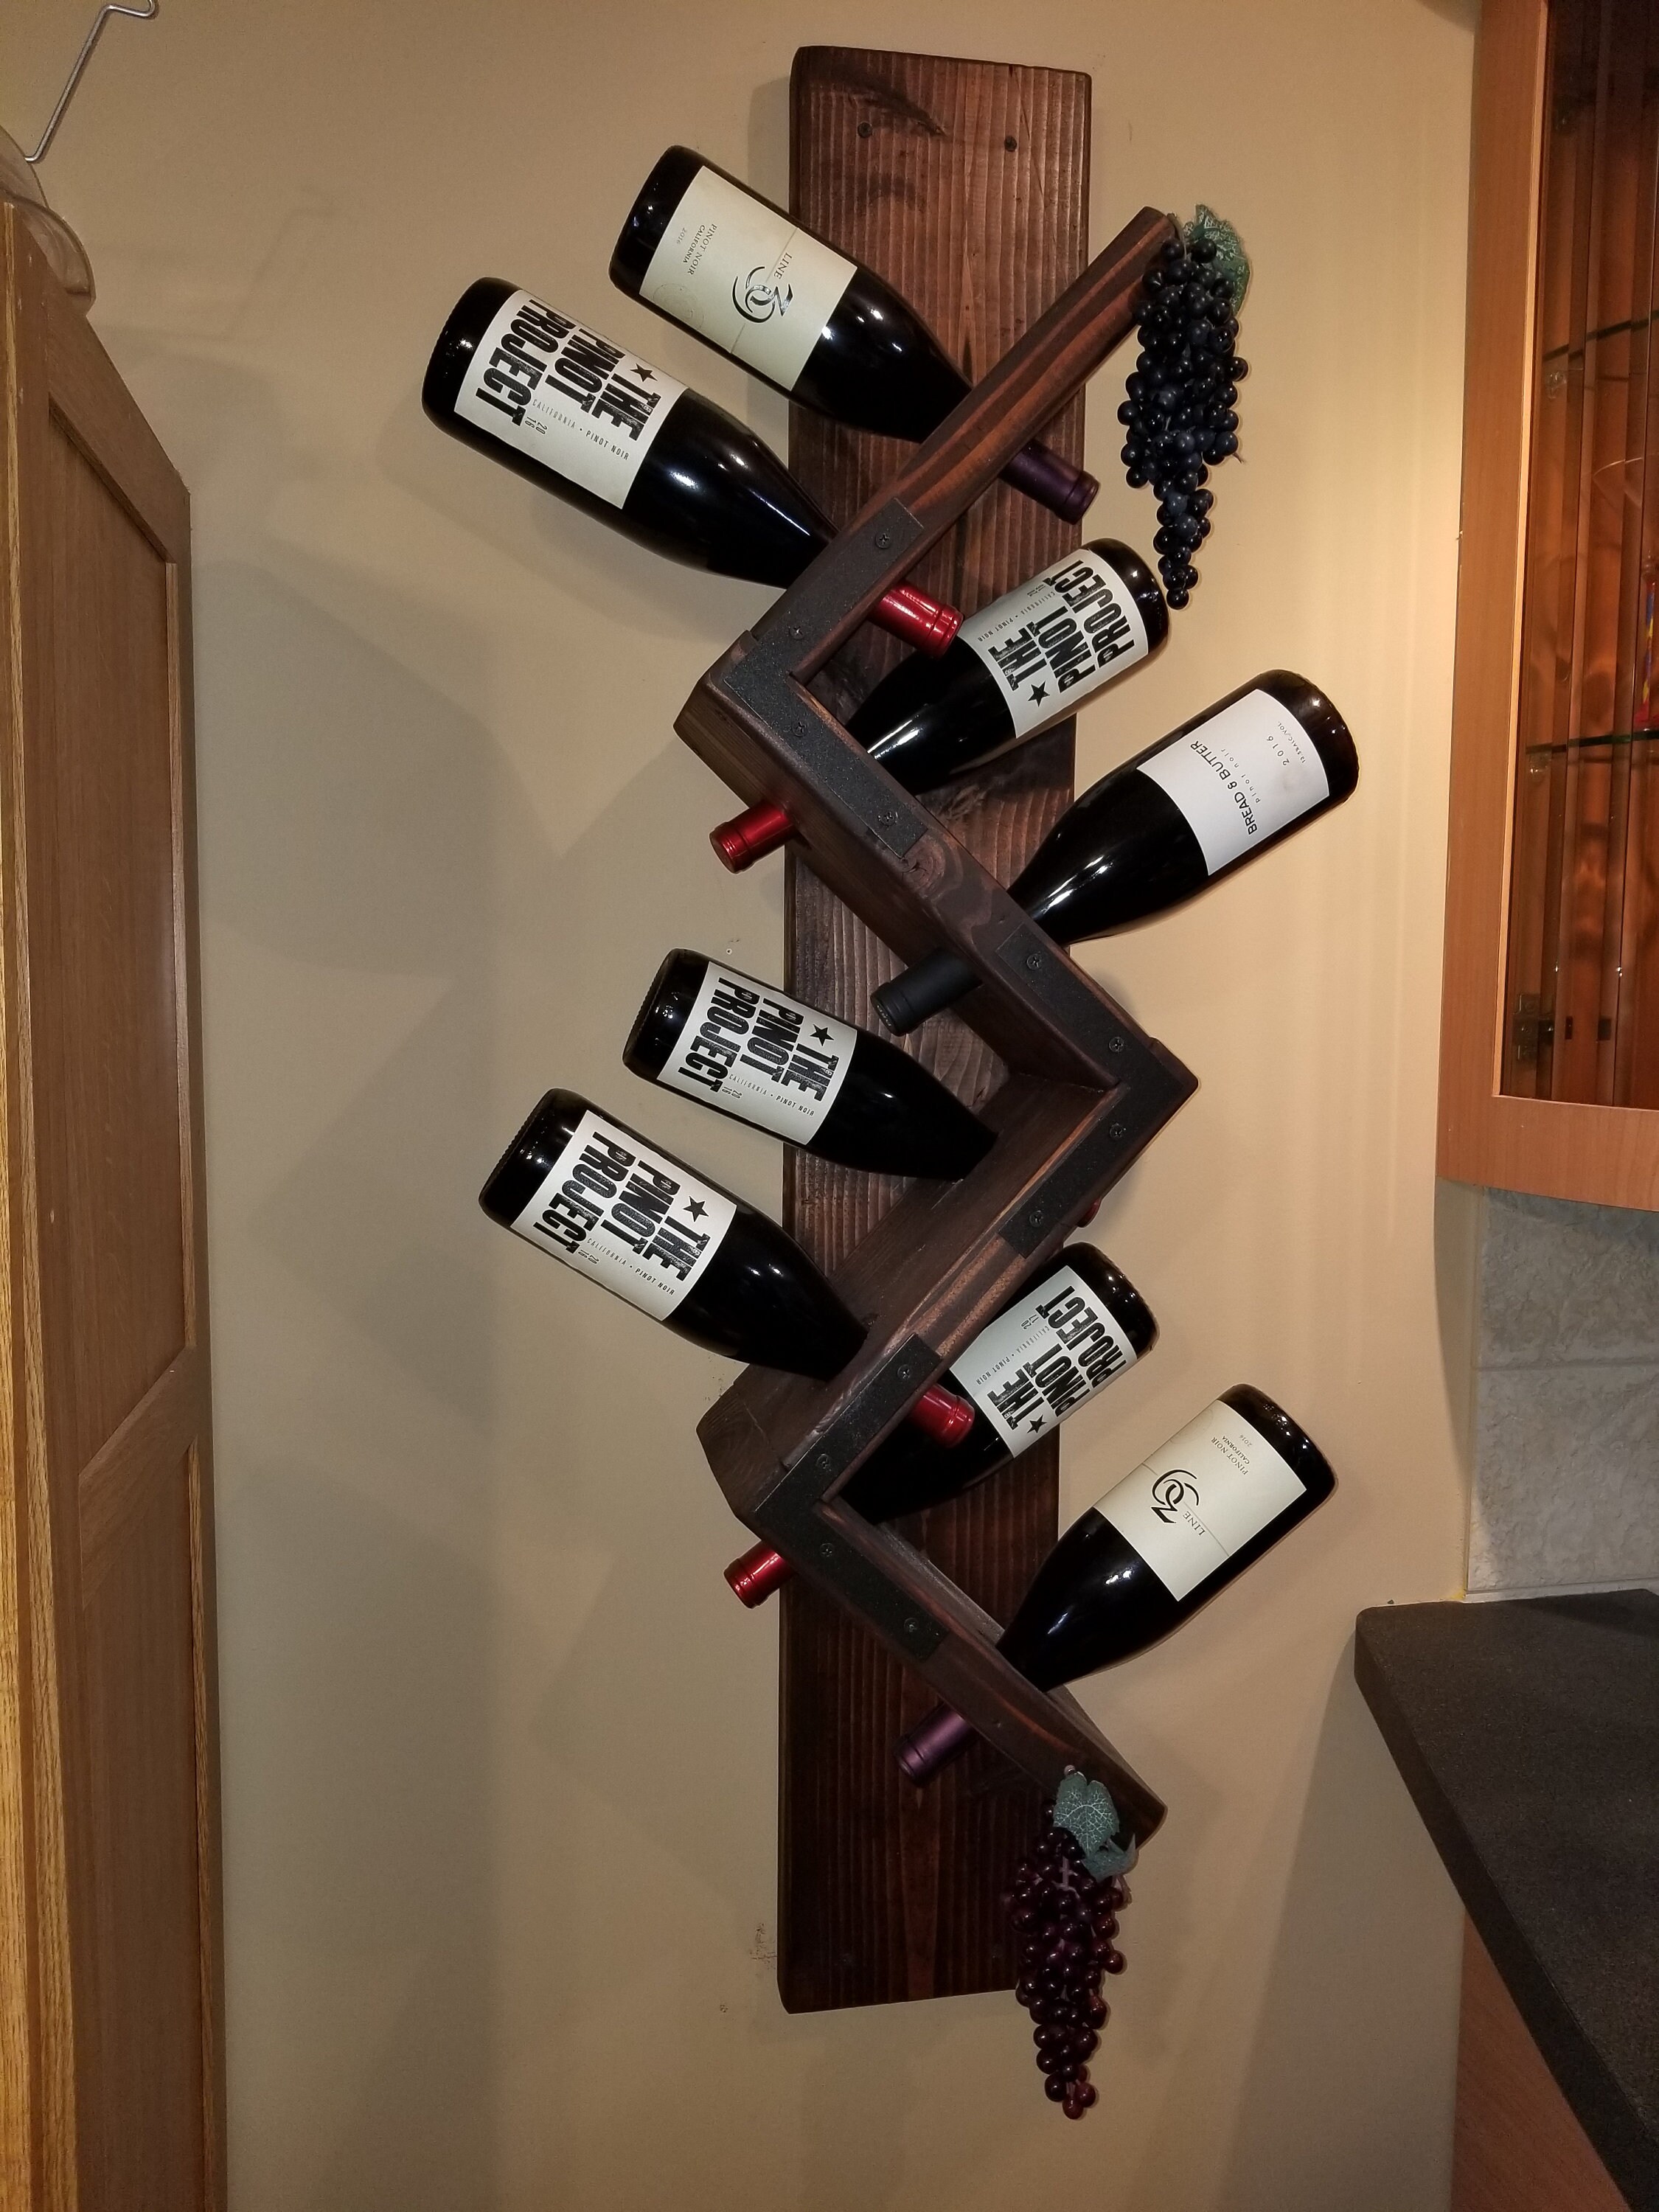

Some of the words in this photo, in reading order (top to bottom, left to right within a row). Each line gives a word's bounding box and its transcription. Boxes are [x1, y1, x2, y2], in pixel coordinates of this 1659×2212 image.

[683, 225, 706, 263] CALIFORNIA
[700, 223, 717, 251] PINOT
[688, 251, 703, 275] NOIR
[773, 251, 793, 279] LINE
[475, 299, 577, 426] PROJECT
[545, 328, 626, 413] PINOT
[591, 373, 661, 441] THE
[532, 399, 576, 428] CALIFORNIA
[585, 430, 609, 448] PINOT
[611, 445, 629, 460] NOIR
[995, 617, 1014, 634] PINOT
[1043, 560, 1135, 668] PROJECT
[978, 630, 994, 642] NOIR
[1026, 605, 1096, 693] PINOT
[988, 627, 1048, 692] THE
[1190, 740, 1231, 780] BUTTER
[1220, 748, 1239, 768] noir
[1266, 734, 1290, 766] 2016
[1227, 780, 1237, 790] &
[1241, 773, 1261, 804] pinot
[1234, 791, 1258, 835] BREAD
[678, 977, 760, 1093] PROJECT
[740, 998, 804, 1083] PINOT
[781, 1043, 839, 1102] THE
[729, 1074, 767, 1096] CALIFORNIA
[776, 1095, 796, 1108] PINOT
[798, 1105, 815, 1116] NOIR
[533, 1131, 636, 1253] PROJECT
[600, 1160, 681, 1255] PINOT
[587, 1238, 627, 1266] CALIFORNIA
[635, 1267, 656, 1284] PINOT
[657, 1281, 675, 1295] NOIR
[641, 1215, 711, 1281] THE
[1016, 1326, 1051, 1354] CALIFORNIA
[1035, 1285, 1127, 1388] PROJECT
[976, 1371, 992, 1385] NOIR
[993, 1357, 1010, 1374] PINOT
[1023, 1343, 1091, 1417] PINOT
[987, 1368, 1045, 1430] THE
[1211, 1436, 1229, 1453] NOIR
[1222, 1435, 1250, 1464] CALIFORNIA
[1226, 1453, 1248, 1475] PINOT
[1183, 1511, 1206, 1537] LINE
